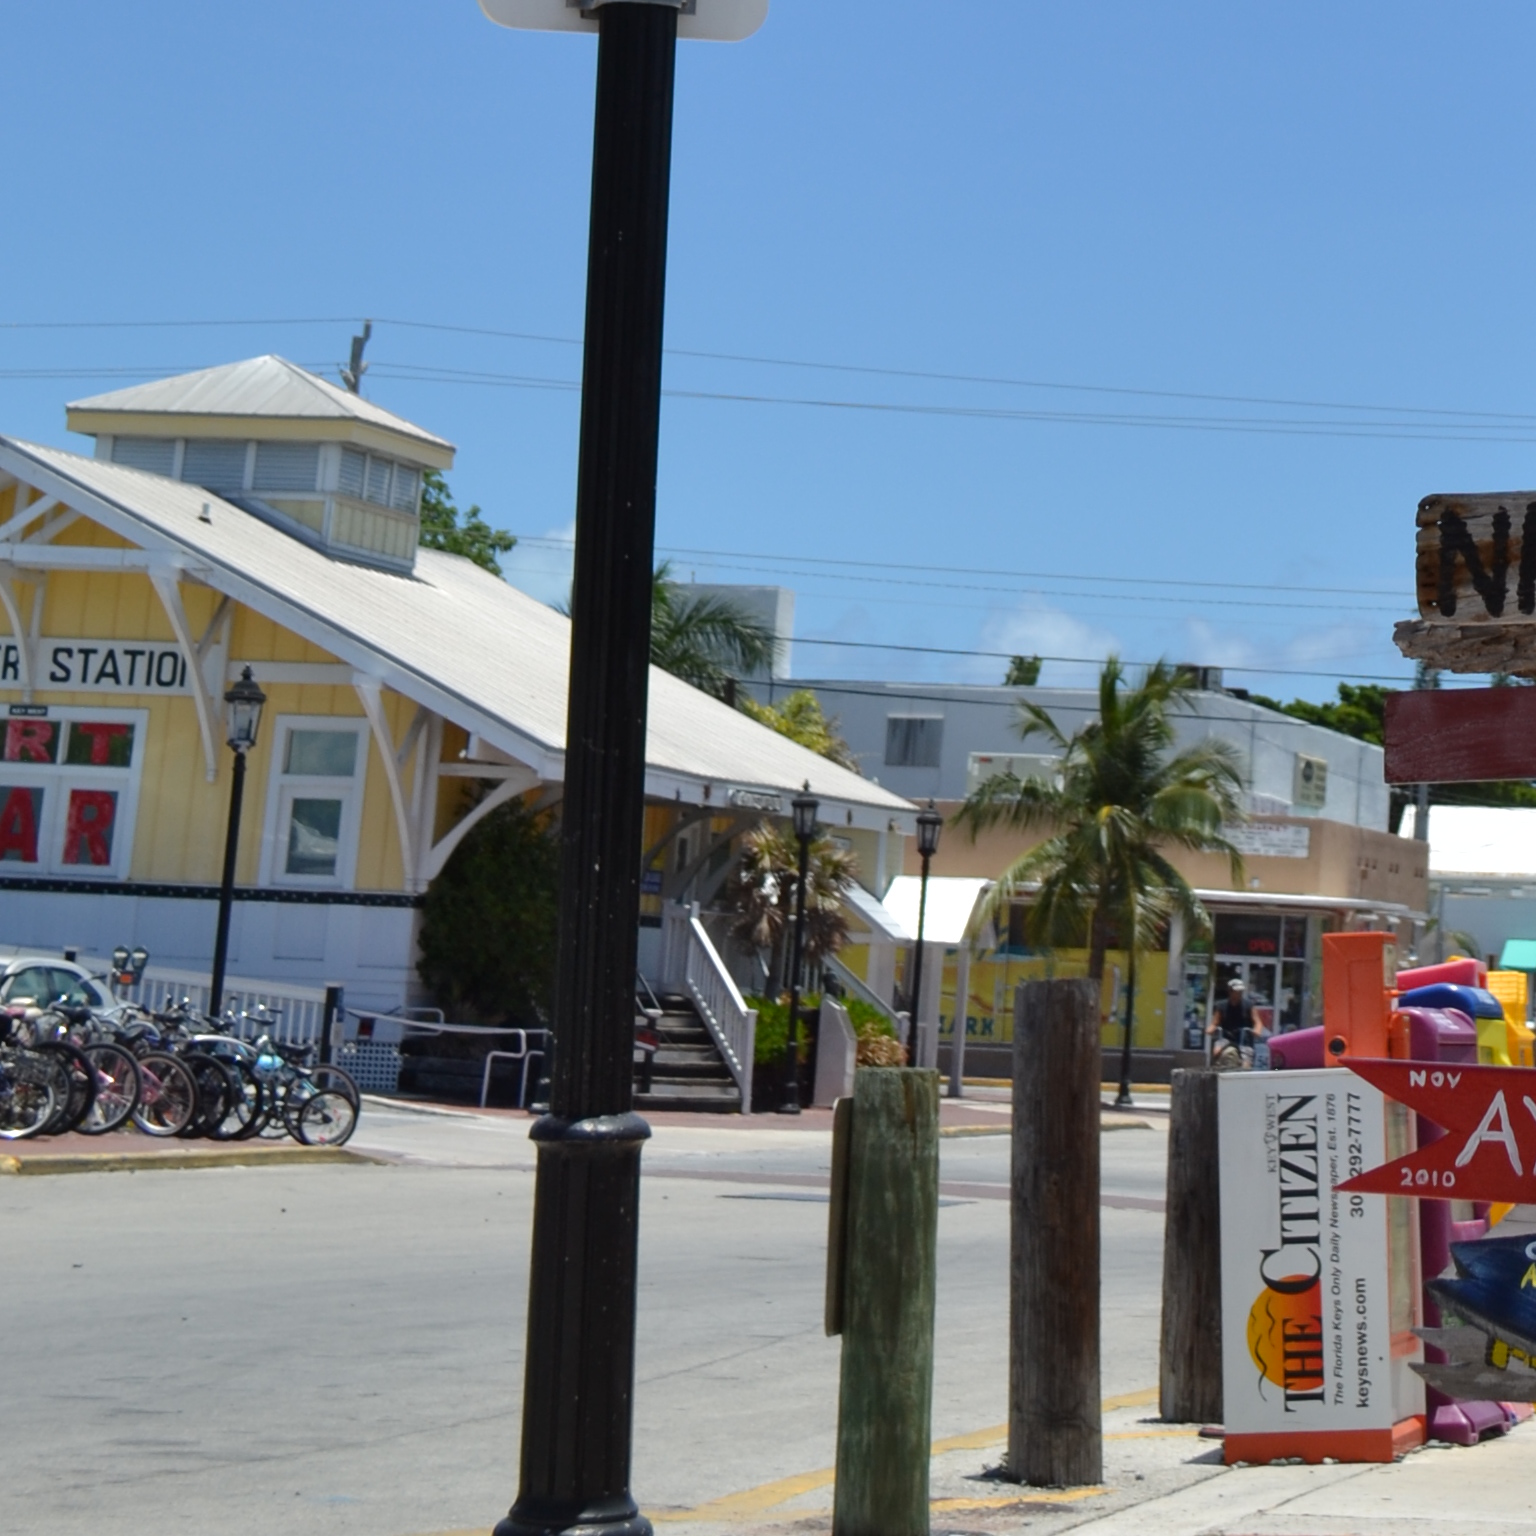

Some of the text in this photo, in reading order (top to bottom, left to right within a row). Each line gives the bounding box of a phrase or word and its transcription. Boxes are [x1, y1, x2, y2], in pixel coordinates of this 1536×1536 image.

[1409, 1069, 1462, 1090] NOV
[1327, 1128, 1338, 1150] Est.
[1266, 1145, 1277, 1174] KEY
[1400, 1167, 1456, 1189] 2010
[1260, 1093, 1325, 1413] THE CITIZEN
[1329, 1232, 1341, 1264] Daily
[1330, 1266, 1343, 1296] Only
[1332, 1299, 1344, 1331] Keys
[1332, 1334, 1344, 1380] Florida
[1355, 1277, 1372, 1408] keysnews.com
[1333, 1382, 1345, 1406] The
